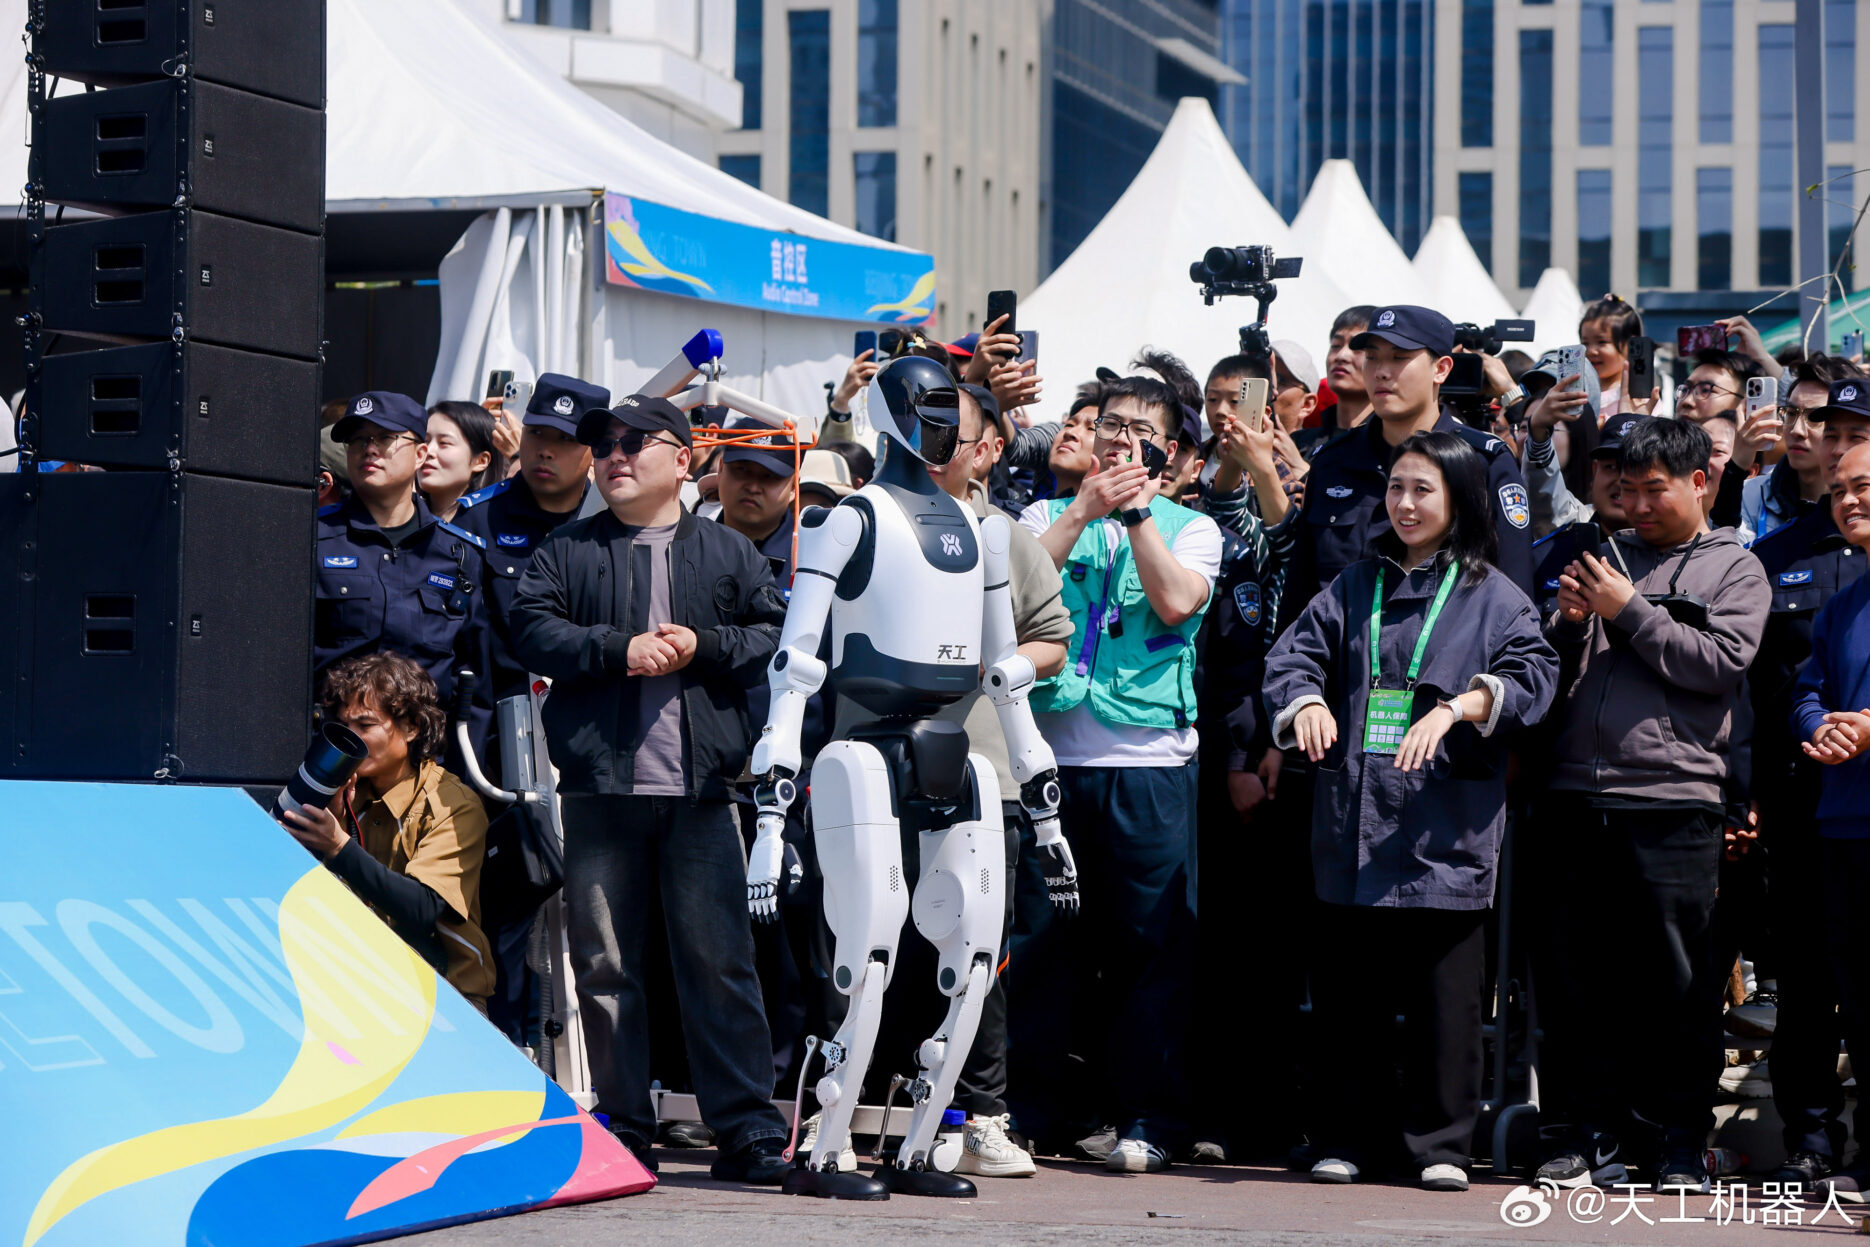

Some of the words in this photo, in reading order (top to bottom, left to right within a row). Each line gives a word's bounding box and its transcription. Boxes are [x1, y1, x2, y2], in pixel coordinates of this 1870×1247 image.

[770, 238, 808, 284] 音控区
[937, 644, 967, 660] 天工
